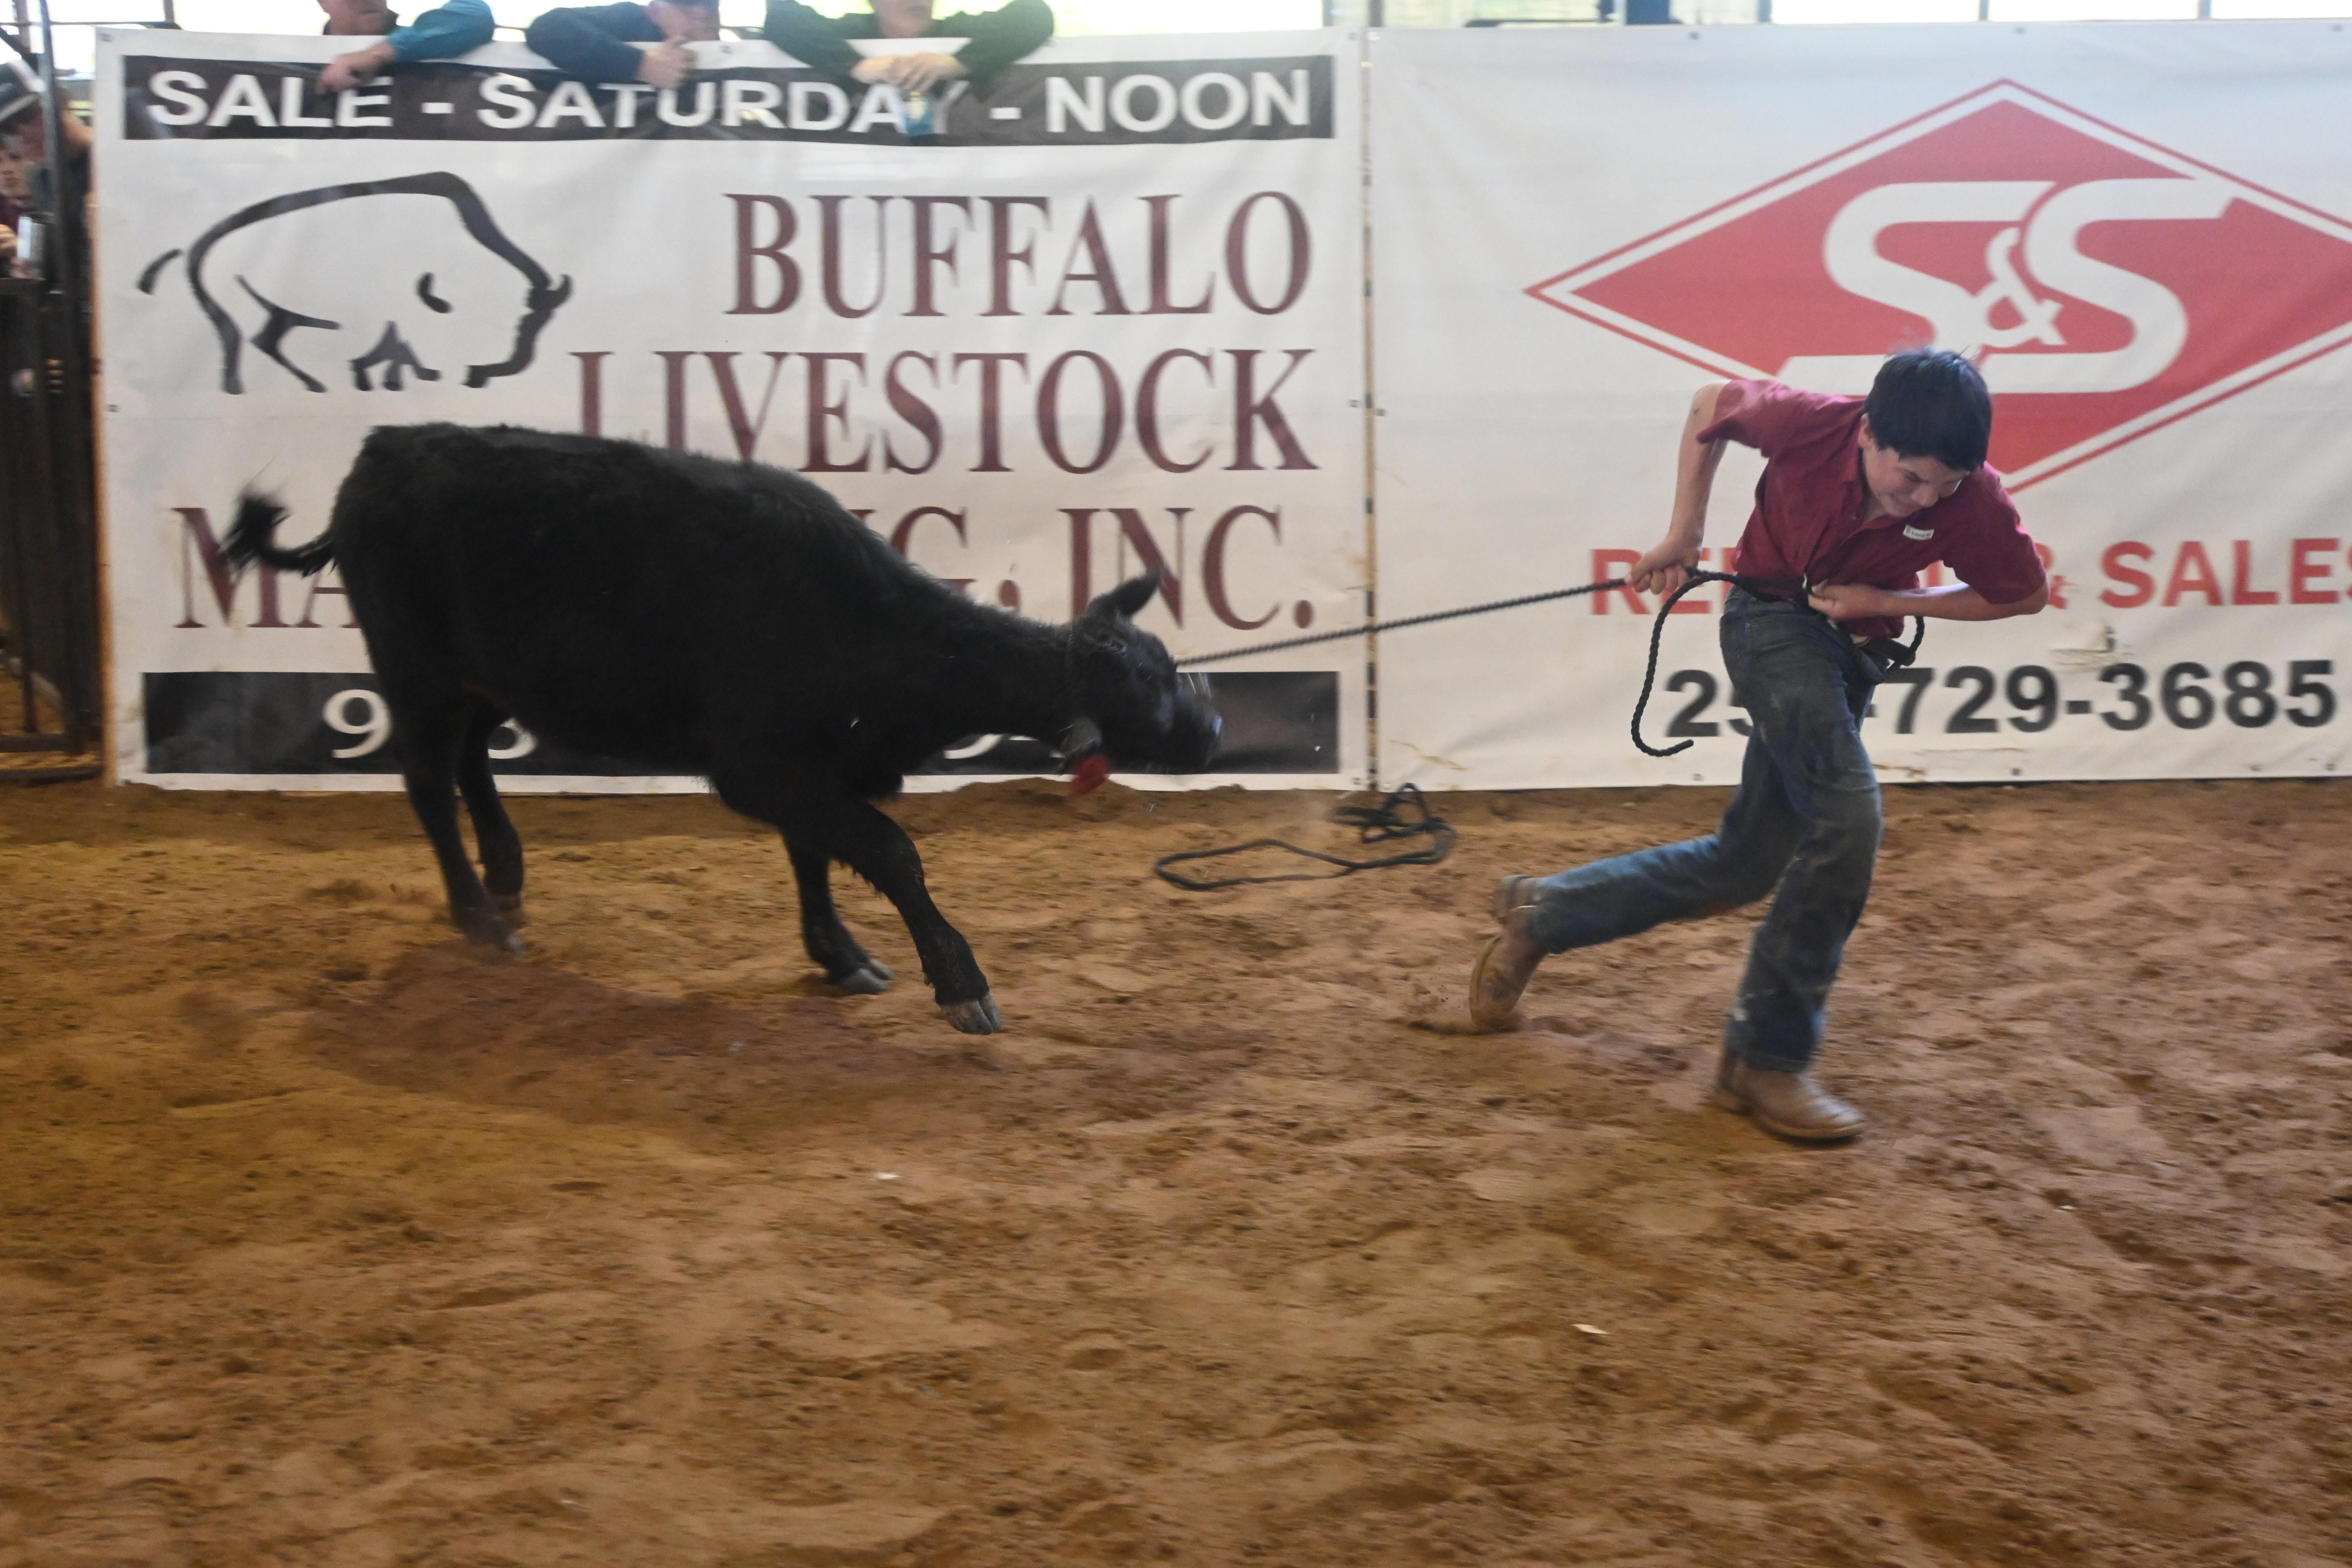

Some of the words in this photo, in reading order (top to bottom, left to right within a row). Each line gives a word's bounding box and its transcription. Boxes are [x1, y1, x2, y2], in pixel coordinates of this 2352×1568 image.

[147, 71, 394, 127] SALE
[421, 102, 454, 114] -
[989, 107, 1022, 120] -
[1045, 70, 1310, 133] NOON
[724, 191, 1312, 318] BUFFALO
[567, 348, 1320, 475] LIVESTOCK
[1058, 504, 1315, 630] INC.
[2101, 537, 2352, 609] SALE
[1664, 659, 2337, 738] 2-729-3685
